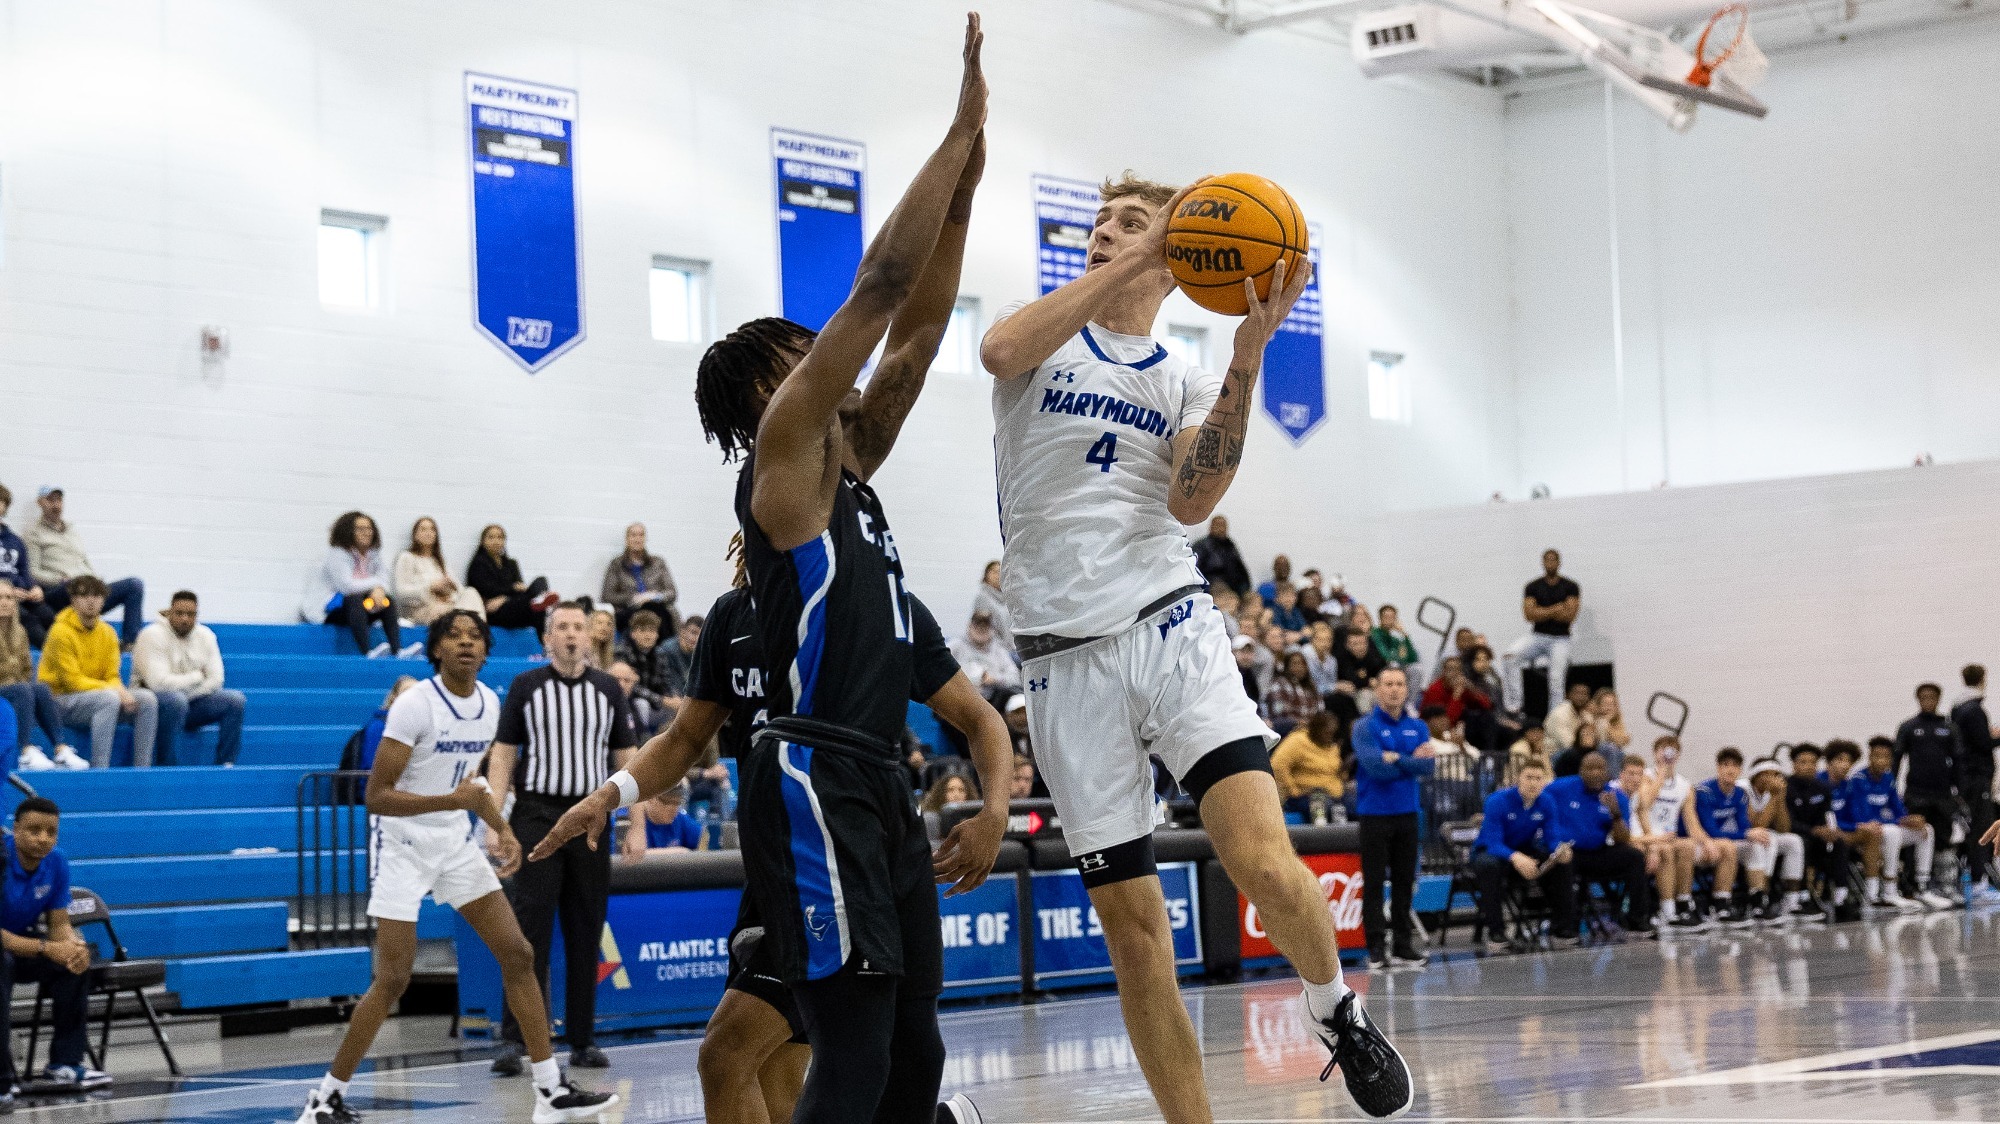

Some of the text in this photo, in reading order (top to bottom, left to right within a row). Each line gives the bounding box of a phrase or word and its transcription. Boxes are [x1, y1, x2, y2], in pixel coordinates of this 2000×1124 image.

[1166, 245, 1245, 273] Wilson
[1085, 431, 1119, 473] 4
[940, 911, 1011, 949] ME OF
[1037, 906, 1083, 940] THE
[638, 938, 715, 962] ATLANTIC
[656, 961, 729, 981] CONFEREN
